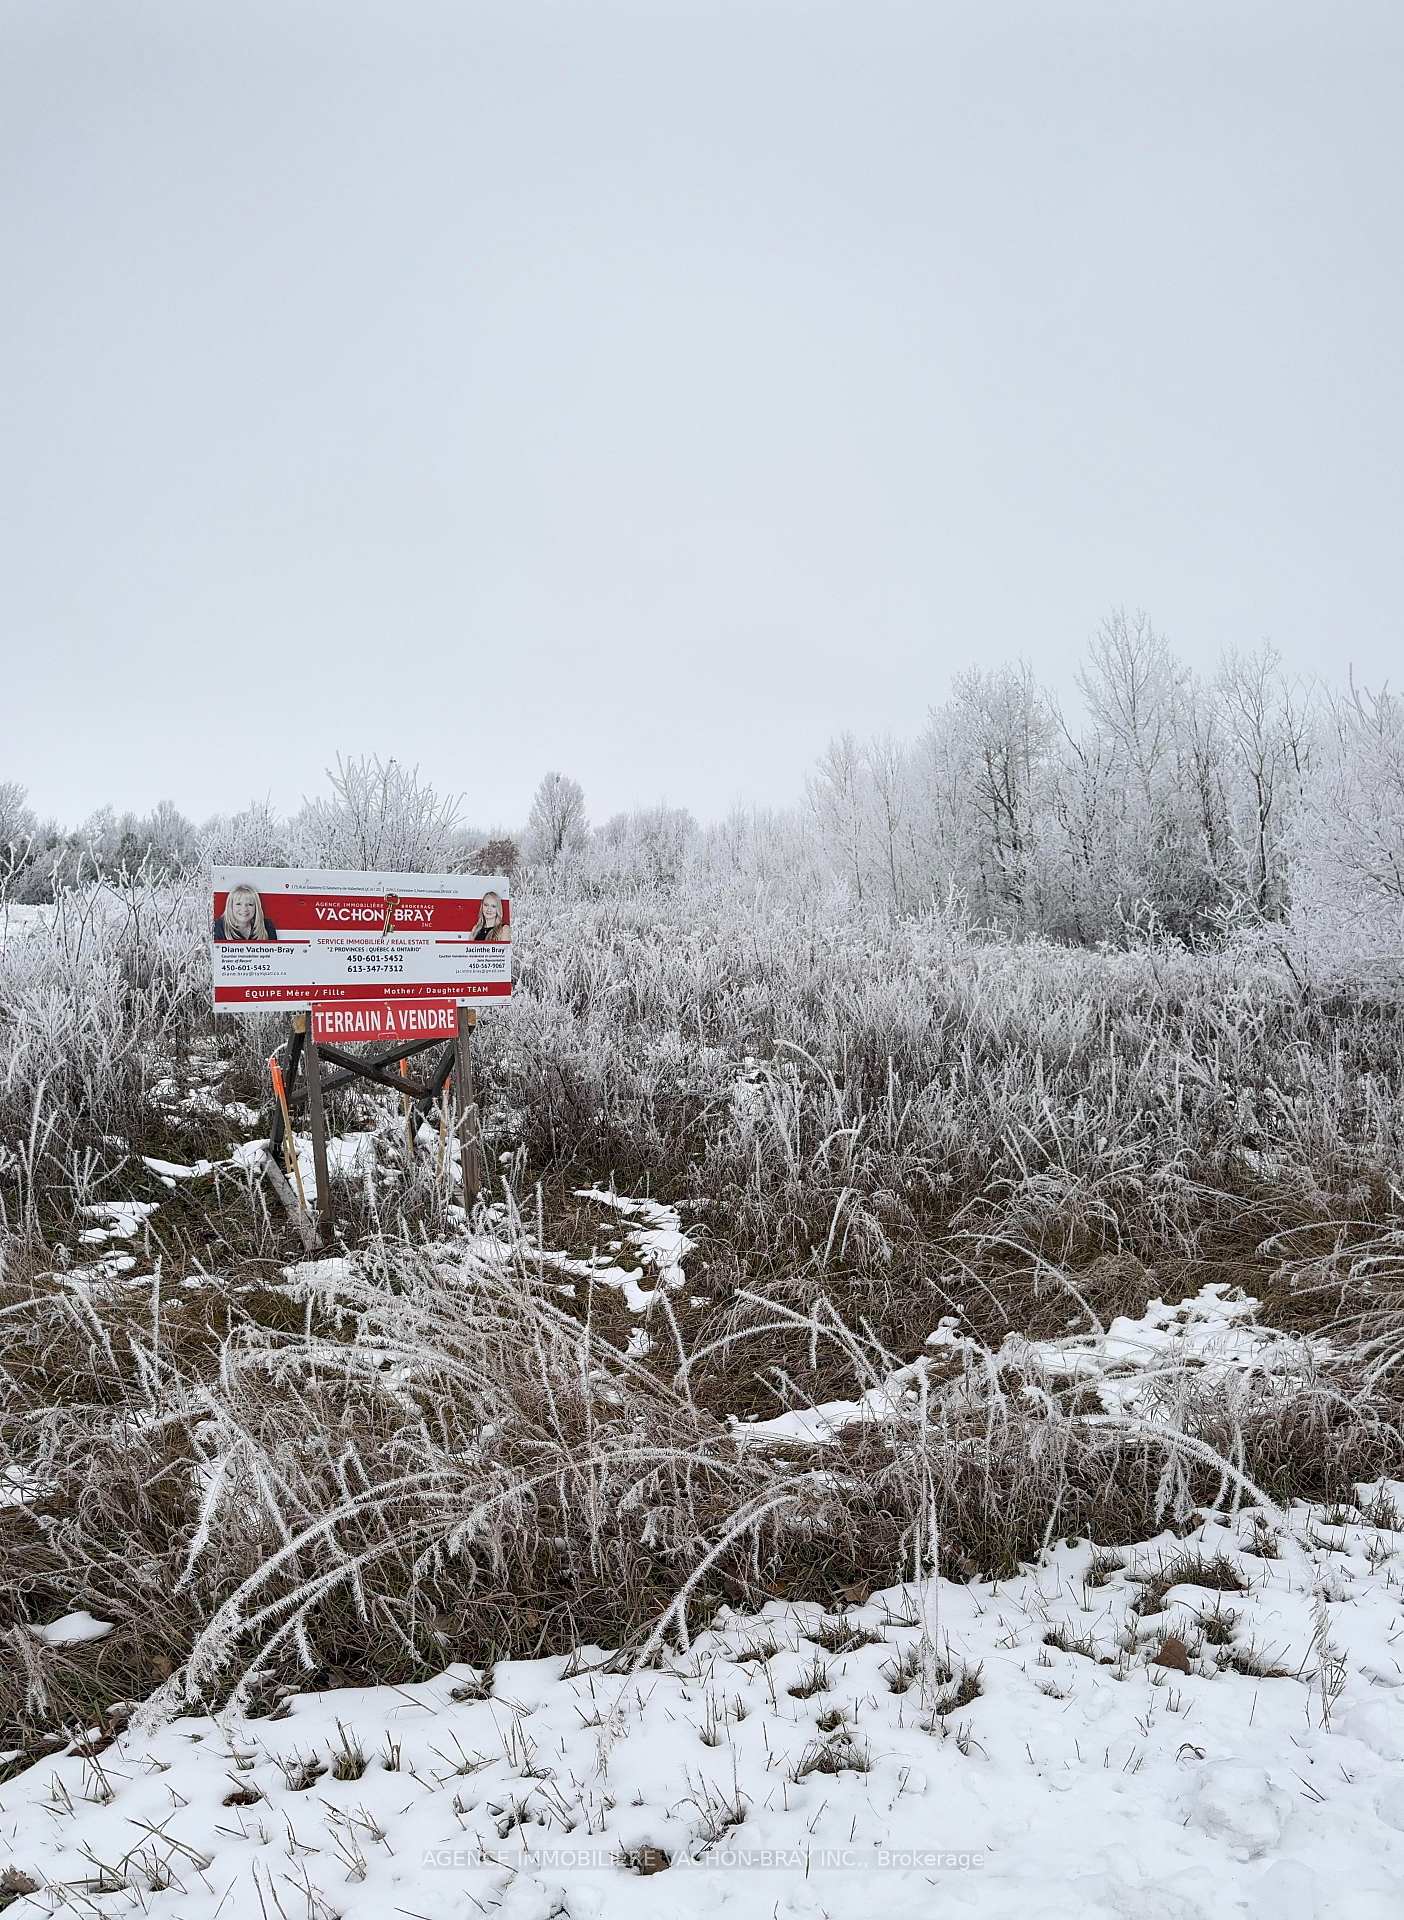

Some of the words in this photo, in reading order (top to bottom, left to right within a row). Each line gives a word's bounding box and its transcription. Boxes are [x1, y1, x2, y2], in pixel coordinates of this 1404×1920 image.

[315, 907, 384, 921] VACHON
[394, 909, 434, 922] BRAY
[246, 946, 295, 955] Vachon-Bray
[491, 946, 505, 954] Bray
[347, 954, 404, 962] 450-601-5452
[347, 964, 404, 973] 613-347-7312
[245, 989, 282, 999] ÉQUIPE
[286, 989, 310, 997] Mère
[384, 987, 415, 995] Mother
[426, 986, 464, 996] Daughter
[315, 1009, 381, 1033] TERRAIN
[385, 1005, 396, 1031] À
[398, 1008, 455, 1031] VENDRE
